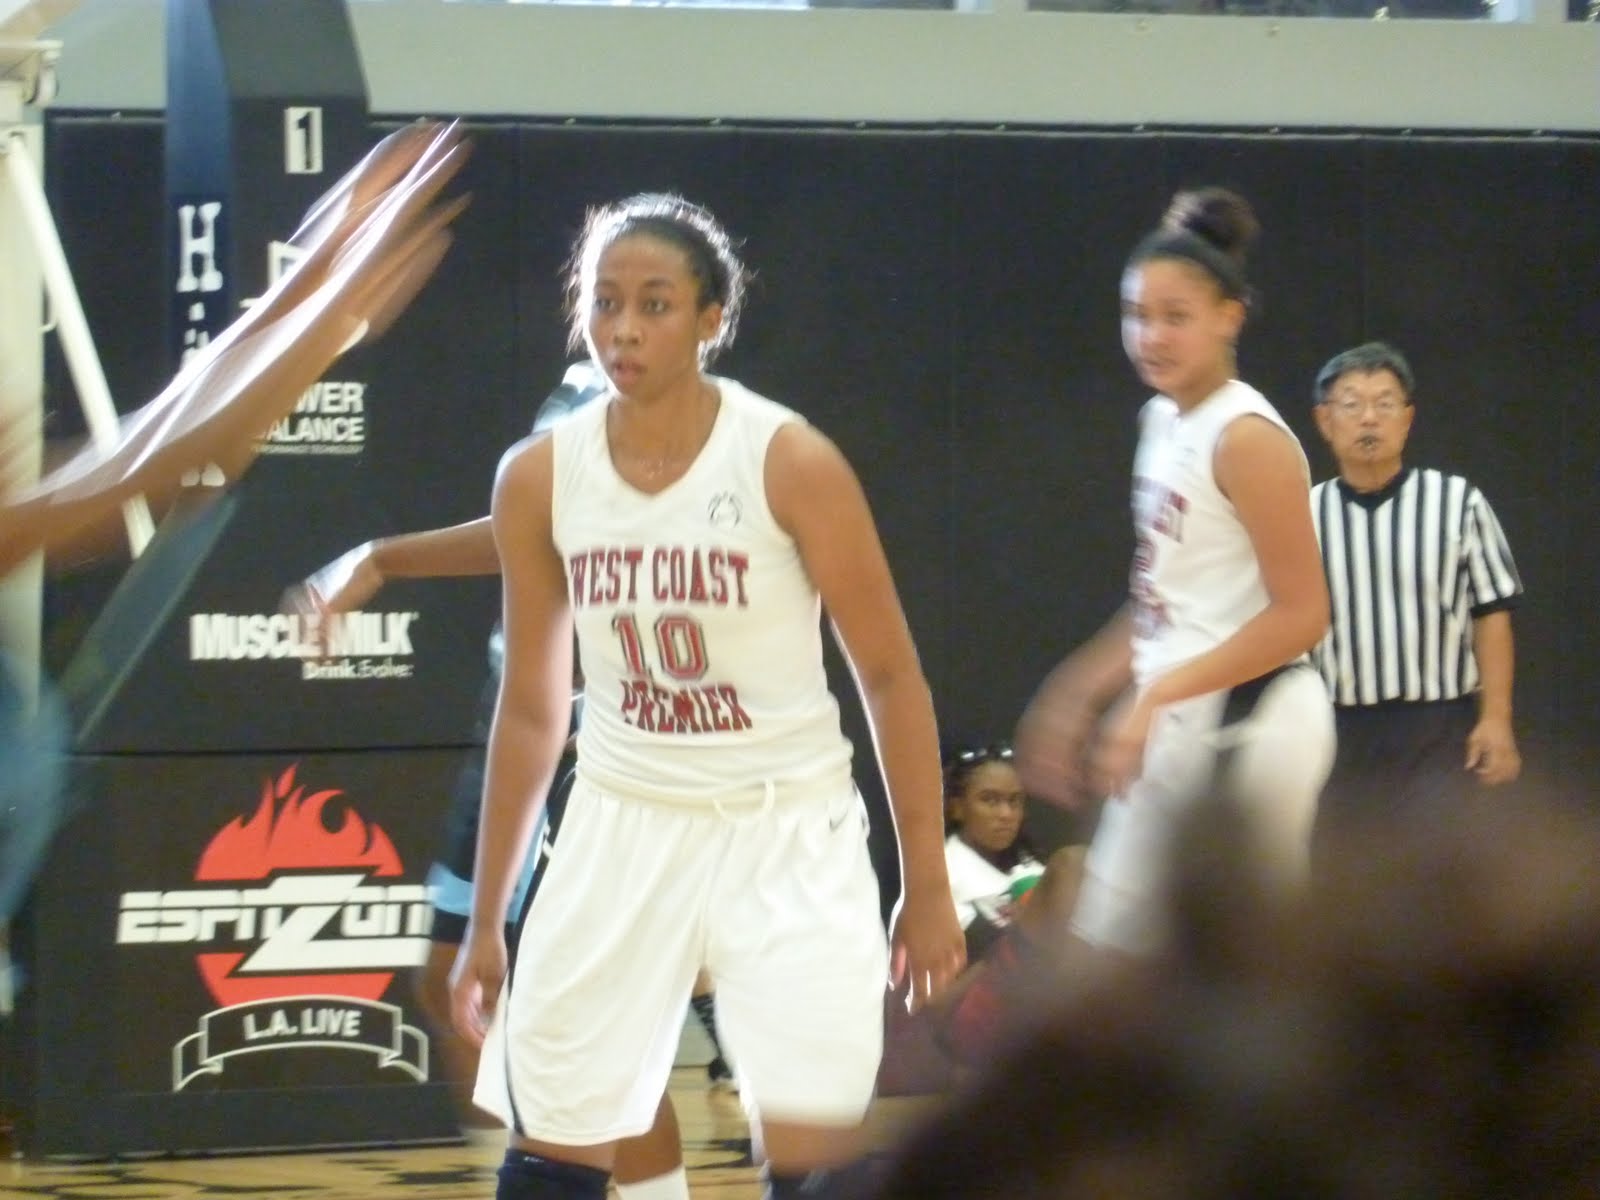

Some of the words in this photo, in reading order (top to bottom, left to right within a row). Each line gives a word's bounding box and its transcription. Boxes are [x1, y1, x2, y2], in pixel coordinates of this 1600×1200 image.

[295, 381, 364, 414] WER
[266, 417, 365, 442] ALANCE
[570, 546, 644, 608] WEST
[652, 546, 749, 608] COAST
[328, 611, 414, 656] MILK
[611, 613, 709, 680] 10
[620, 679, 753, 733] PREMIER
[242, 1009, 299, 1041] L.A.
[301, 1007, 362, 1038] LIVE
